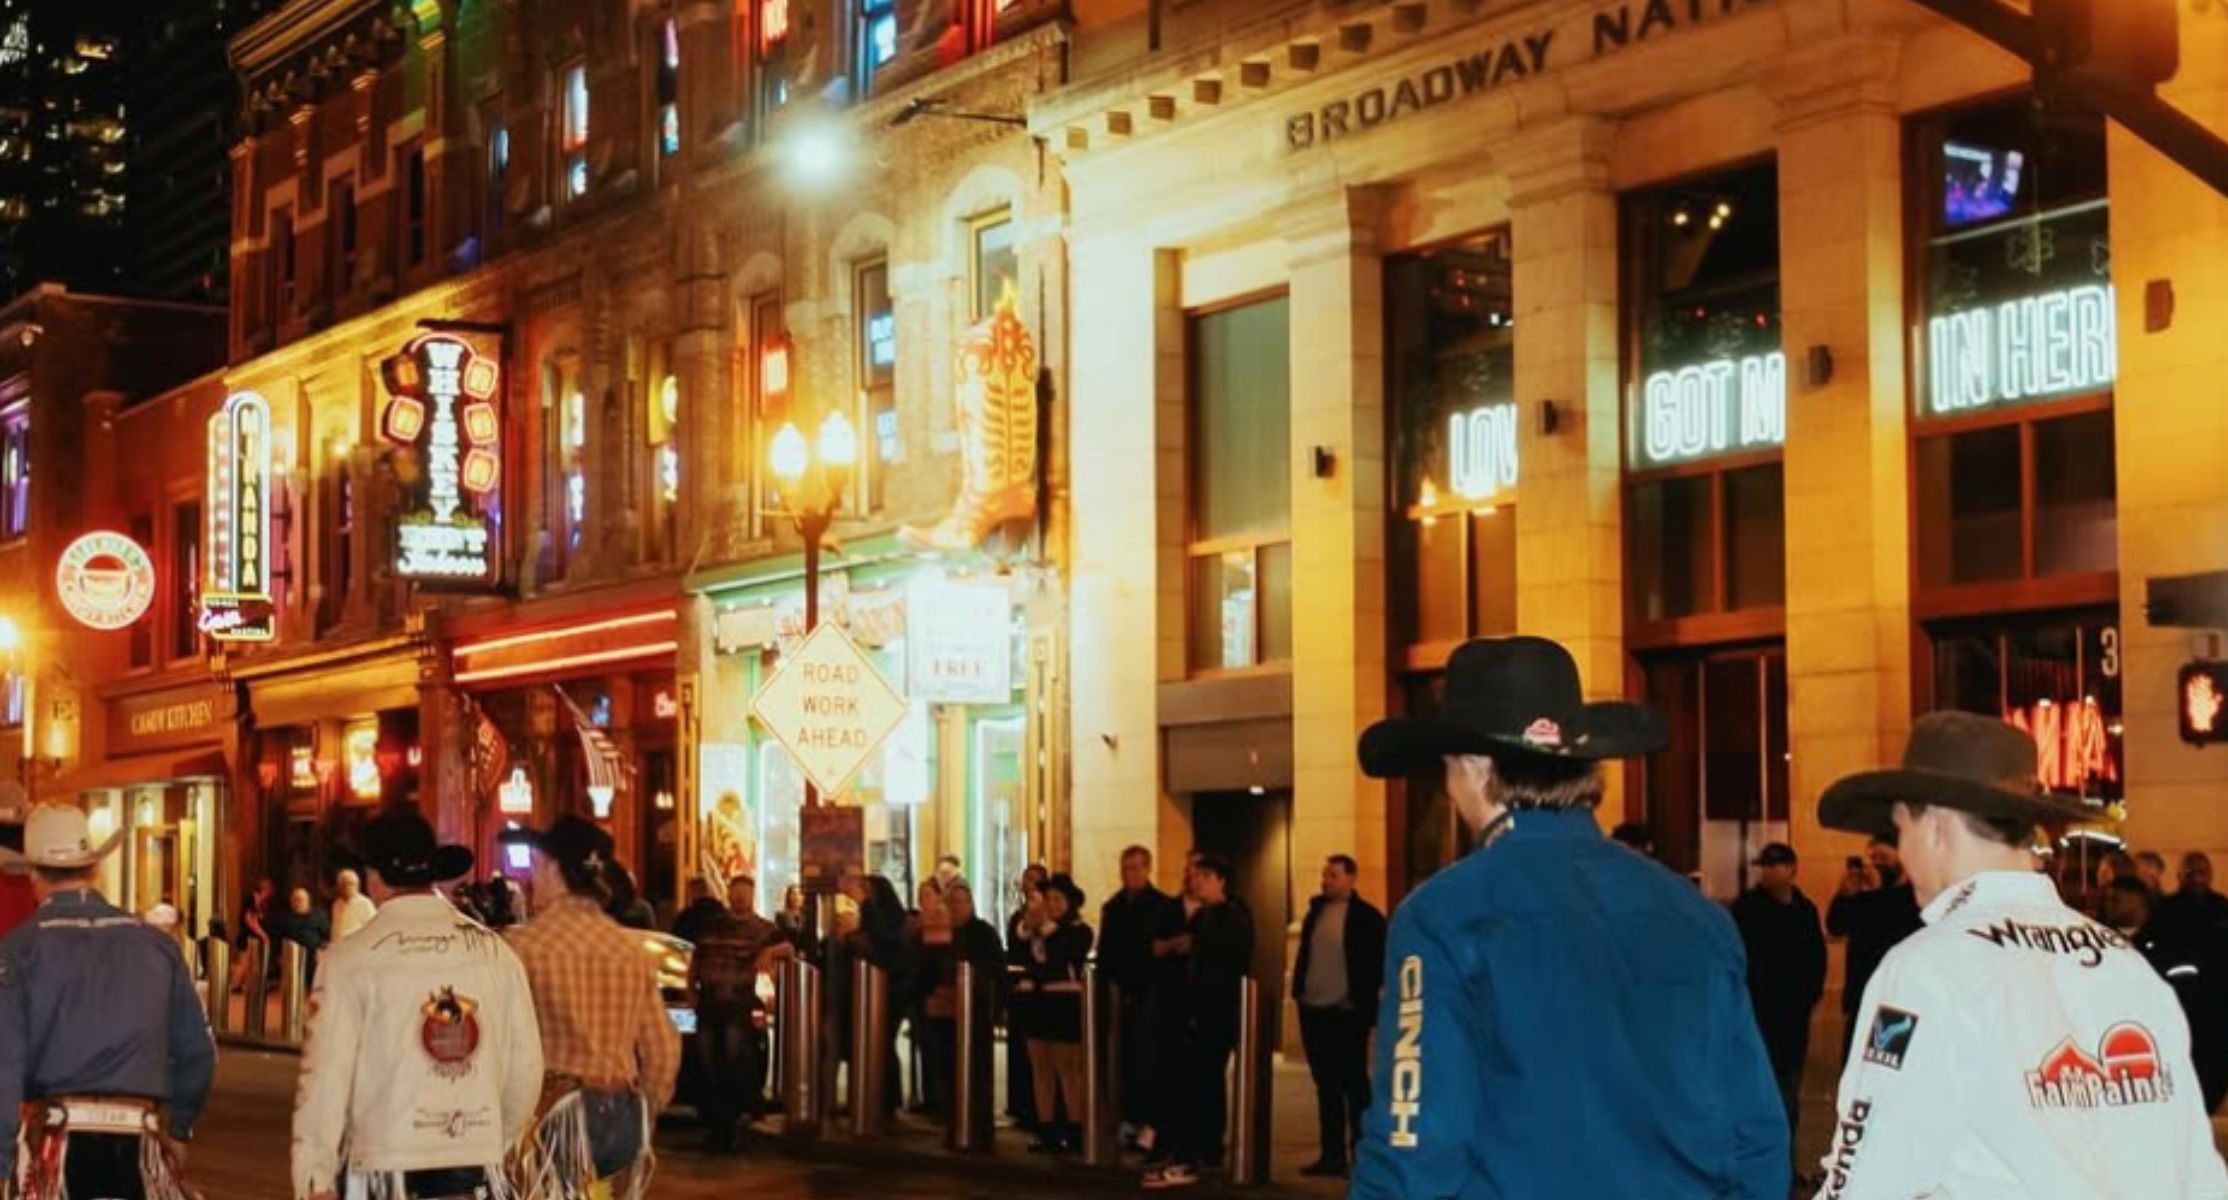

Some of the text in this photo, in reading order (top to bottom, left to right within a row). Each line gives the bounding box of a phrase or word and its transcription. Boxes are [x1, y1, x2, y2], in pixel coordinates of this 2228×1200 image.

[1286, 31, 1552, 152] BROADWAY
[1930, 285, 2117, 413] IN HER
[425, 341, 463, 524] WHISKEY
[1645, 360, 1732, 461] GOT
[239, 405, 261, 588] MIRANDA
[802, 663, 860, 684] ROAD
[803, 696, 859, 716] WORK
[797, 728, 868, 748] AHEAD
[1966, 917, 2134, 968] Wrangle
[1390, 955, 1422, 1147] CINCH
